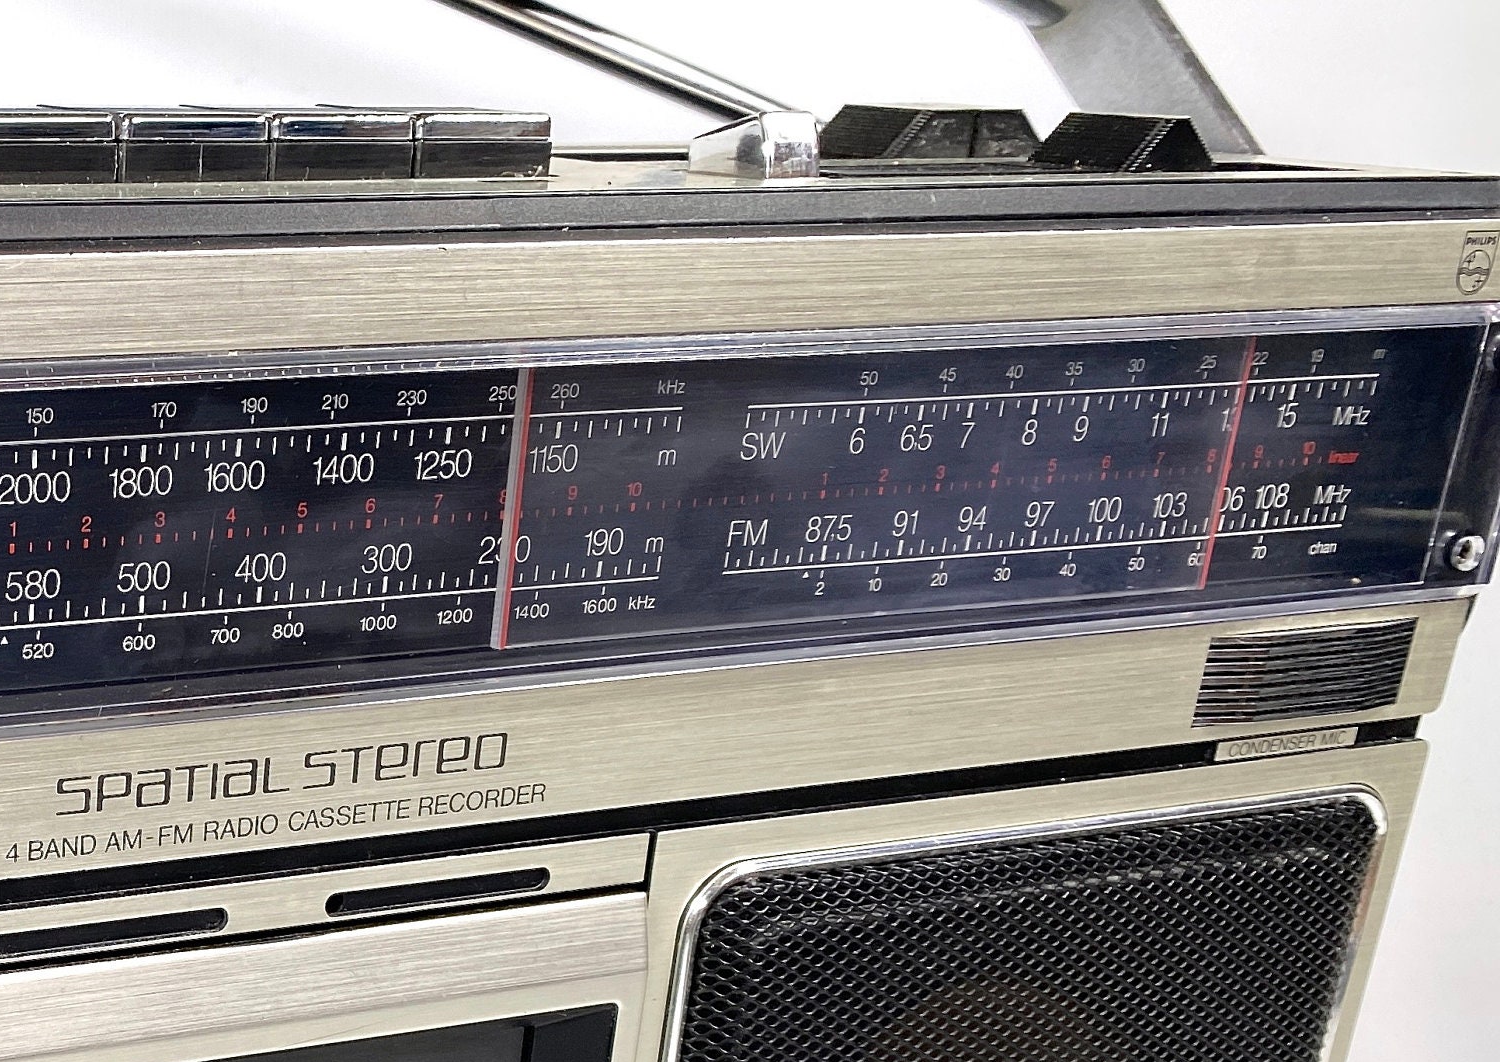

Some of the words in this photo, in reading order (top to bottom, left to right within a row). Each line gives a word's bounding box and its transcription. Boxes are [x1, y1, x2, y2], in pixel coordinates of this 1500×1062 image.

[1467, 236, 1497, 245] PHILIPS
[860, 371, 879, 386] 50
[939, 368, 957, 382] 45
[1006, 365, 1024, 379] 40
[1066, 361, 1083, 375] 35
[1127, 358, 1145, 373] 30
[1200, 355, 1217, 369] 25
[1253, 351, 1269, 365] 22
[26, 407, 53, 424] 150
[151, 402, 177, 418] 170
[241, 396, 268, 413] 190
[322, 393, 349, 410] 210
[397, 389, 427, 406] 230
[489, 385, 517, 401] 250
[551, 382, 580, 399] 260
[657, 378, 685, 395] kHz
[740, 432, 786, 460] SW
[849, 427, 866, 454] 6
[961, 422, 975, 448] 7
[1021, 418, 1038, 446] 8
[1072, 415, 1089, 442] 9
[1151, 413, 1170, 437] 11
[1277, 403, 1299, 428] 15
[1332, 406, 1371, 425] MHz
[109, 465, 173, 499] 1800
[204, 460, 265, 492] 1600
[313, 453, 375, 486] 1400
[414, 449, 472, 481] 1250
[530, 445, 578, 474] 1150
[658, 449, 676, 467] m
[9, 522, 17, 537] 1
[81, 517, 92, 532] 2
[155, 512, 165, 528] 3
[226, 508, 236, 523] 4
[297, 503, 308, 517] 5
[365, 499, 376, 513] 6
[435, 495, 444, 509] 7
[568, 486, 577, 500] 9
[627, 482, 642, 497] 10
[727, 519, 769, 547] FM
[893, 510, 919, 537] 91
[958, 506, 988, 533] 94
[1025, 501, 1055, 527] 97
[1088, 497, 1122, 523] 100
[1154, 492, 1188, 518] 103
[1255, 483, 1290, 510] 108
[1313, 485, 1351, 505] MHz
[5, 569, 61, 601] 580
[117, 561, 171, 592] 500
[234, 552, 286, 583] 400
[361, 543, 412, 574] 300
[585, 528, 624, 556] 190
[645, 536, 664, 553] m
[815, 582, 825, 596] 2
[868, 578, 882, 592] 10
[931, 572, 948, 587] 20
[993, 567, 1011, 582] 30
[1059, 563, 1077, 577] 40
[1128, 557, 1145, 571] 50
[1252, 546, 1267, 559] 70
[1308, 542, 1337, 555] chan
[22, 642, 54, 659] 520
[122, 635, 155, 652] 600
[211, 627, 240, 645] 700
[272, 623, 304, 639] 800
[360, 615, 397, 631] 1000
[437, 608, 472, 624] 1200
[514, 603, 549, 619] 1400
[582, 597, 616, 614] 1600
[628, 594, 655, 610] kHz
[1229, 734, 1316, 757] CONDENSER
[1320, 731, 1346, 746] MIC
[5, 844, 20, 863] 4
[27, 836, 97, 862] BAND
[105, 823, 194, 851] AM-FM
[203, 814, 279, 841] RADIO
[287, 799, 411, 832] CASSETTE
[417, 783, 546, 817] RECORDER
